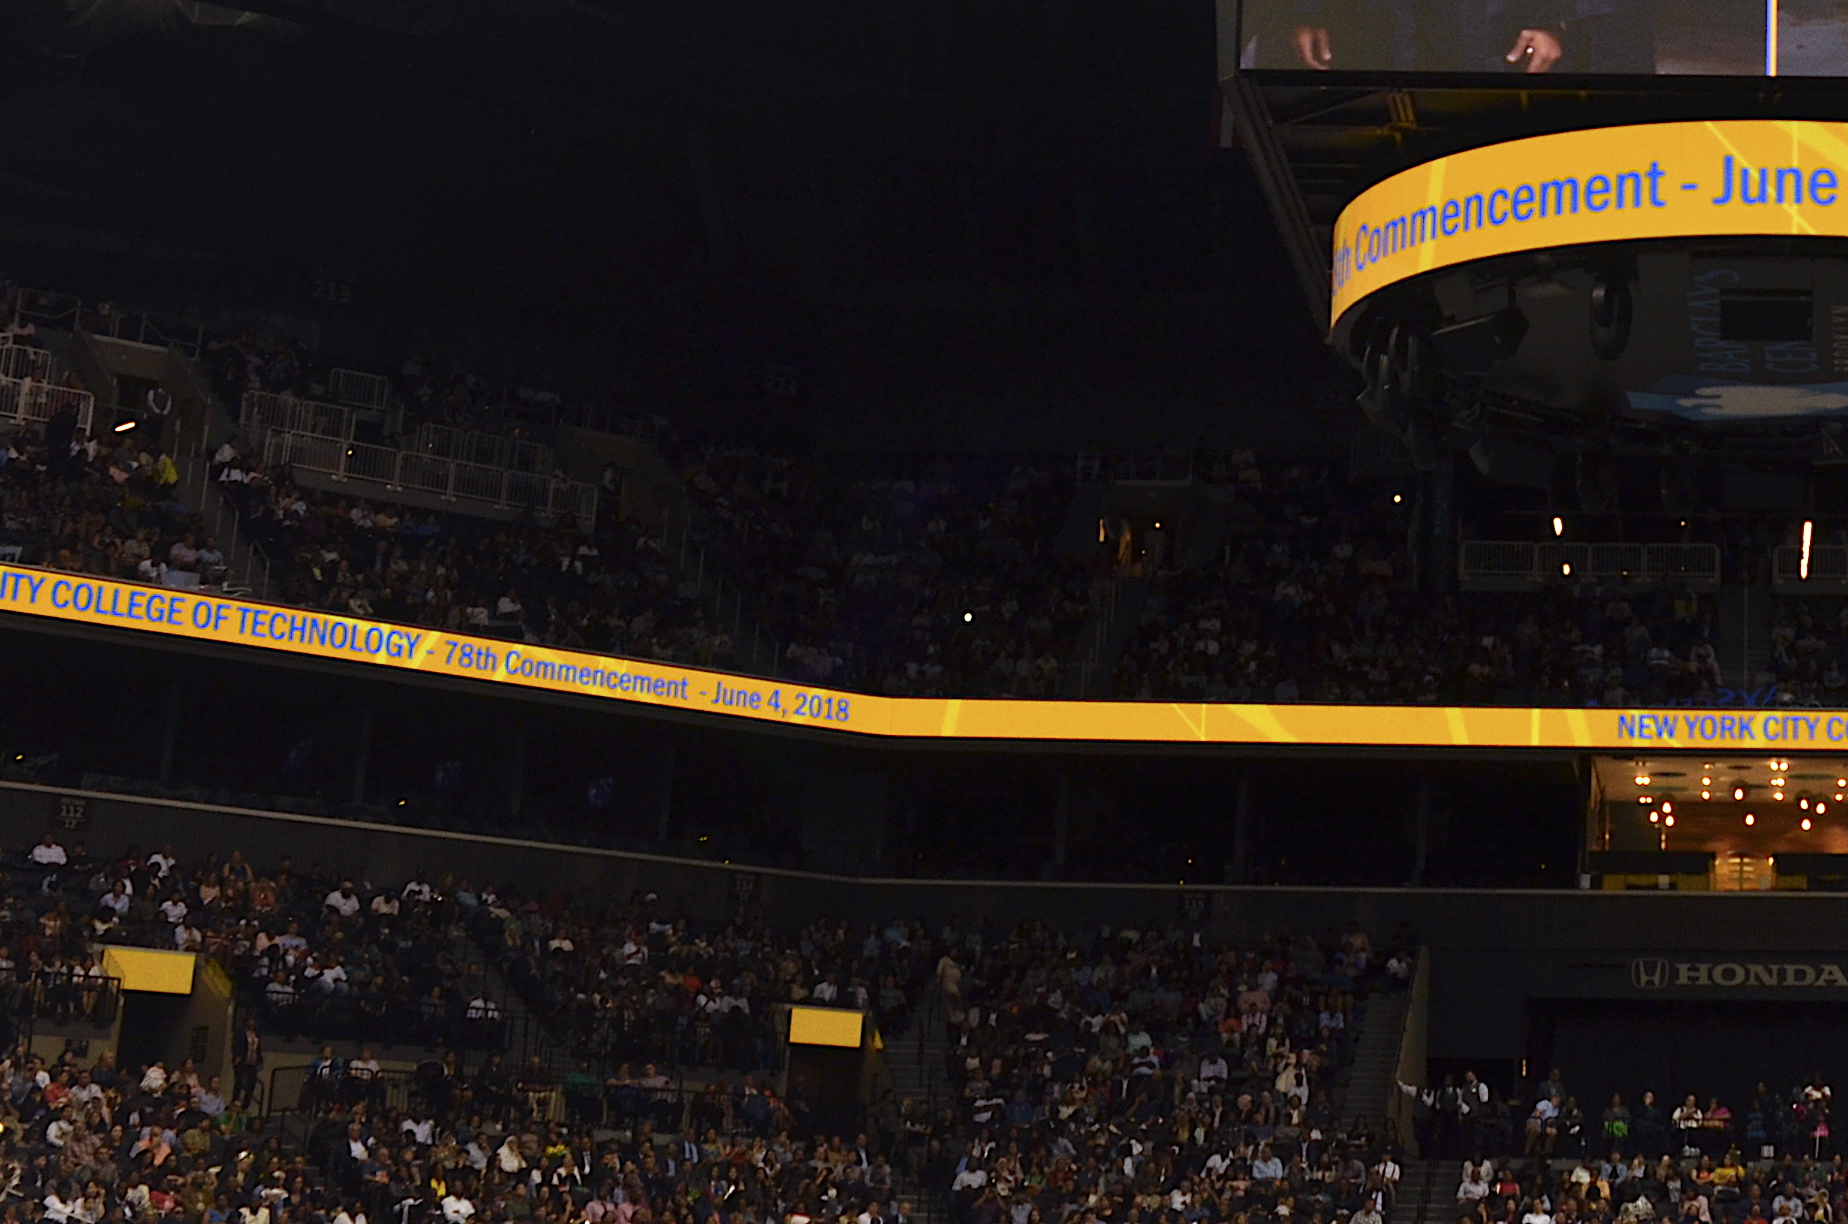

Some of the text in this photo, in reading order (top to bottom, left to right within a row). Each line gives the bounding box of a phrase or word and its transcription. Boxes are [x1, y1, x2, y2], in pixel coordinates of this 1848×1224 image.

[1354, 159, 1667, 272] Commencement
[1681, 182, 1699, 192] -
[1712, 154, 1839, 207] June
[51, 579, 186, 626] COLLEGE
[193, 600, 231, 631] OF
[238, 607, 422, 660] TECHNOLOGY
[445, 641, 498, 672] 78th
[505, 649, 690, 701] Commencement
[712, 681, 763, 710] June
[768, 688, 788, 717] 4,
[794, 692, 850, 722] 2018
[1618, 713, 1679, 740] NEW
[1684, 714, 1756, 741] YORK
[1762, 715, 1820, 742] CITY
[60, 805, 84, 818] 112
